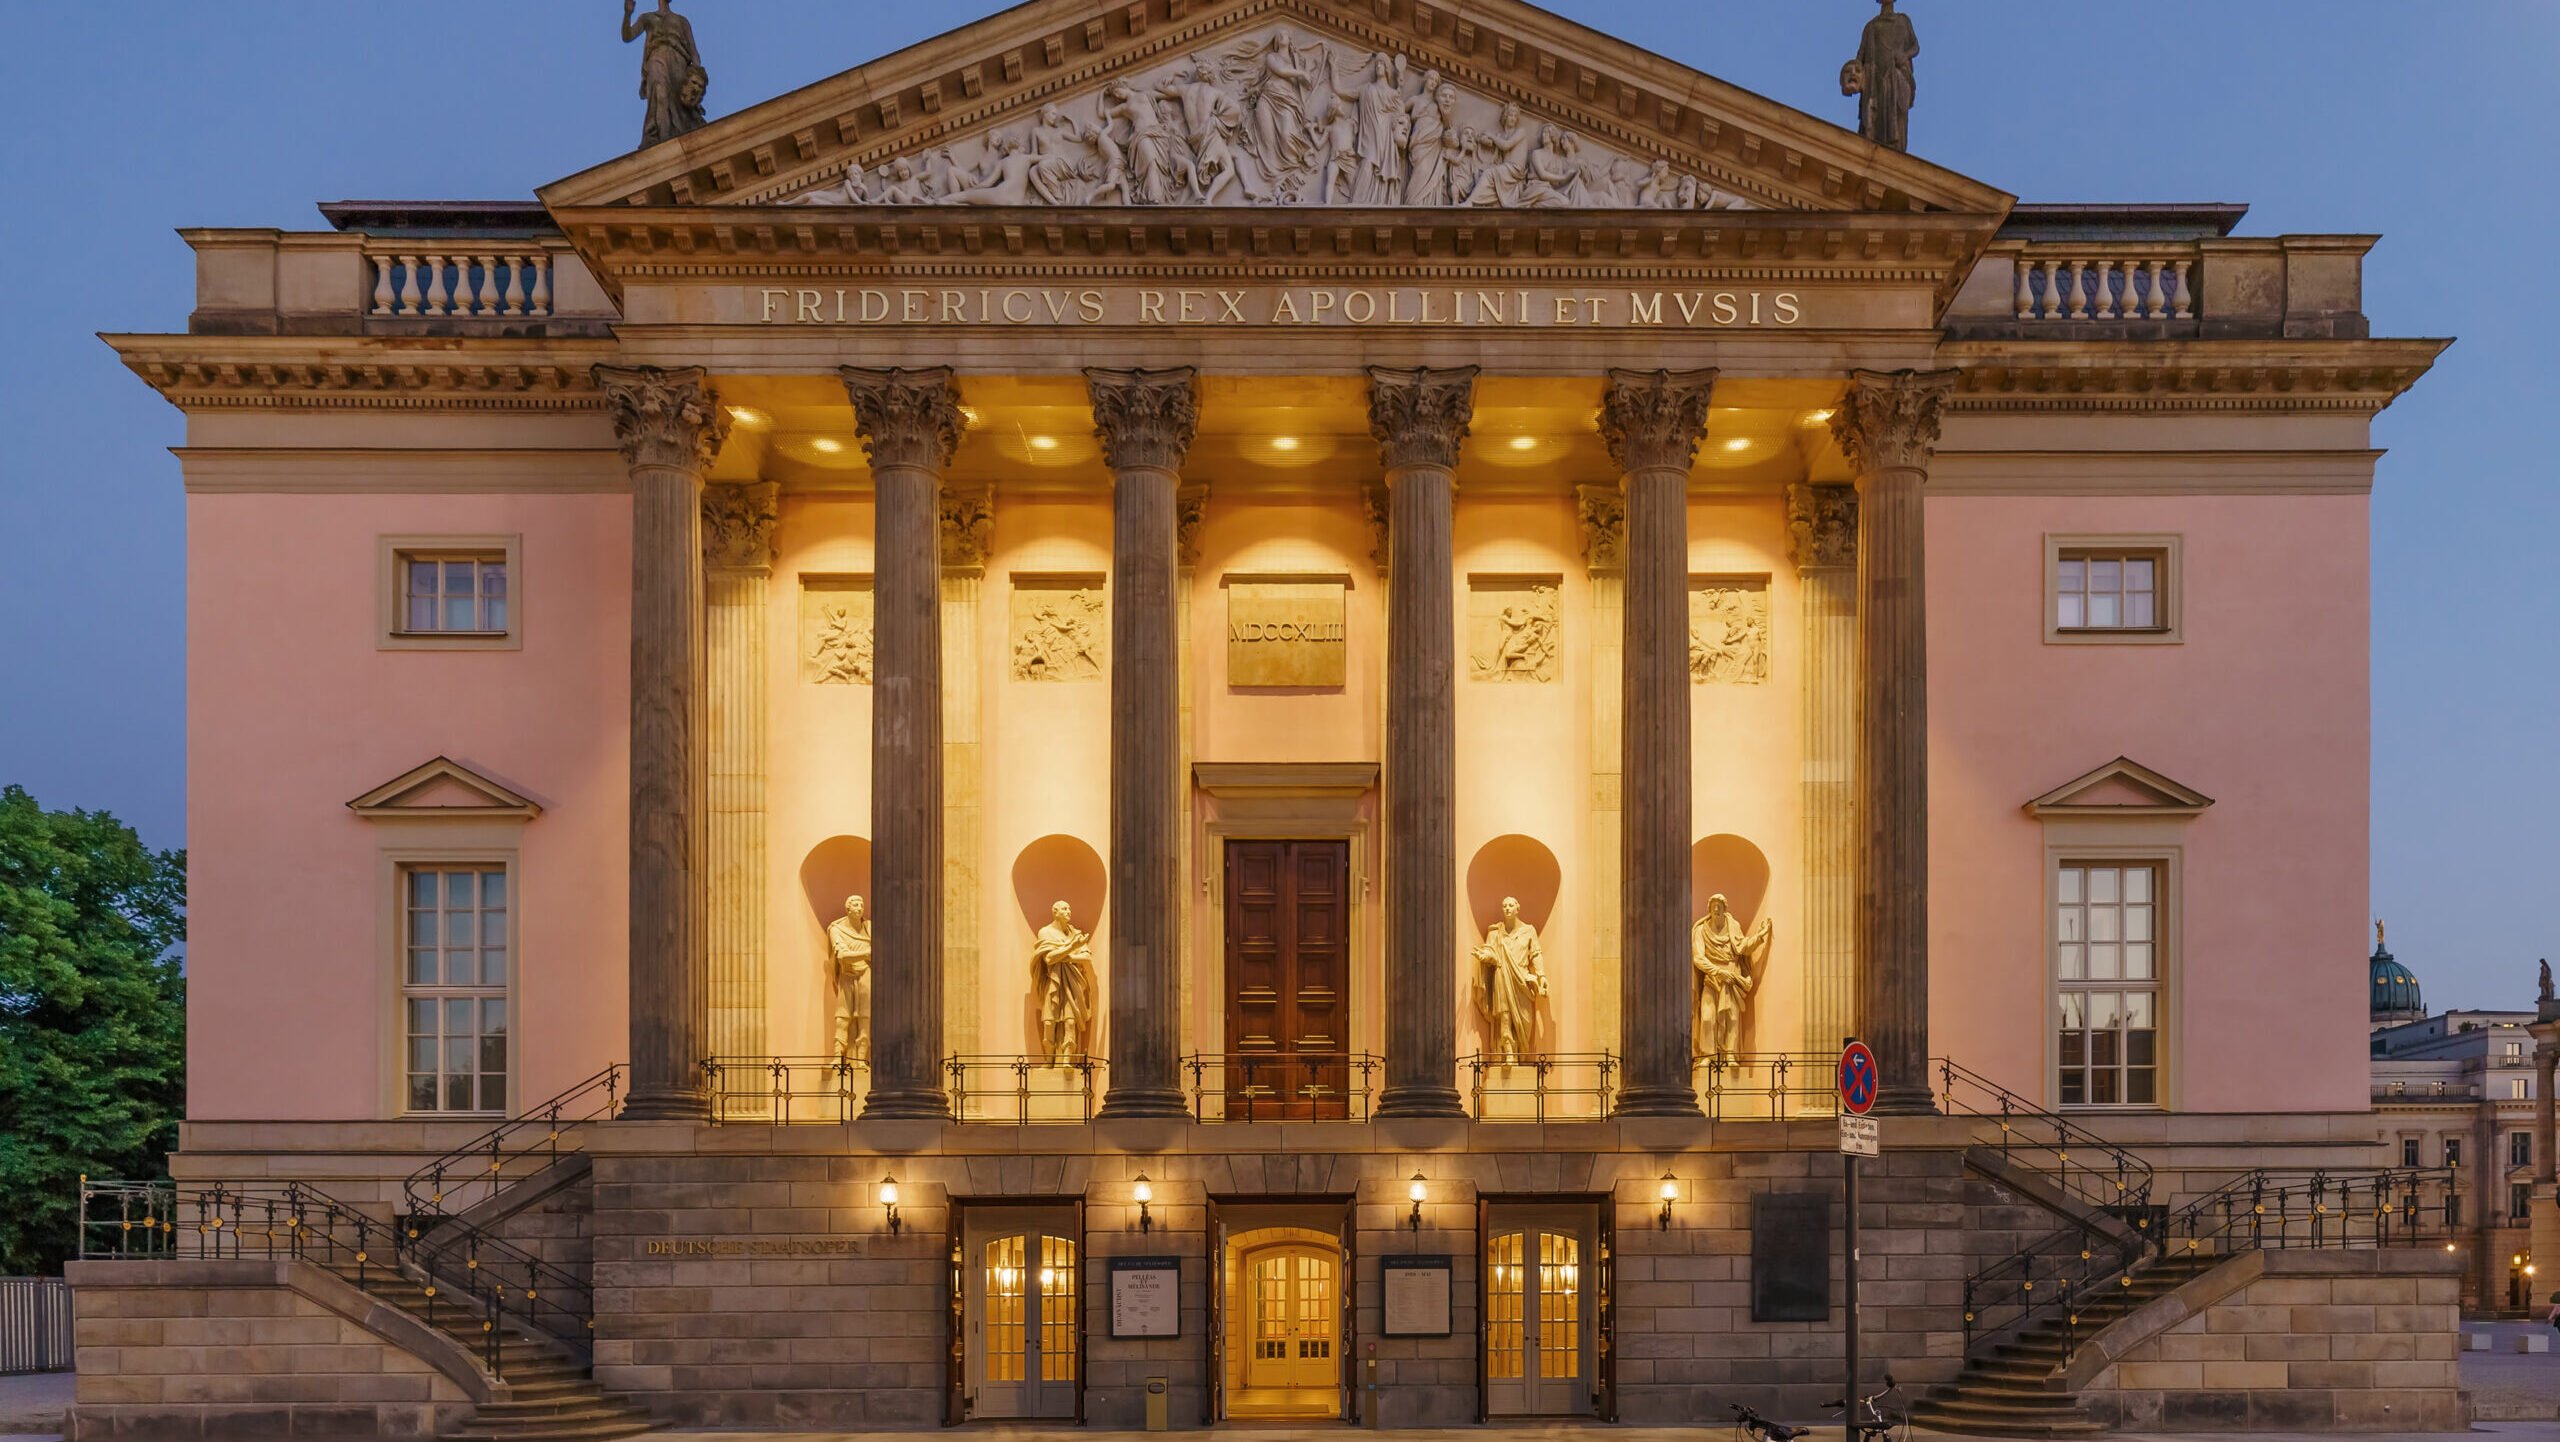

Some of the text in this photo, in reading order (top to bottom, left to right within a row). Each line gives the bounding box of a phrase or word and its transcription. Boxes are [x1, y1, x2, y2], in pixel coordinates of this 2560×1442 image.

[761, 289, 1800, 324] FRIDERICVS REX APOLLINI ET MVSIS
[1230, 623, 1343, 643] MDCCXLIII
[647, 1240, 862, 1255] DEUTSCHE STAATSOPER
